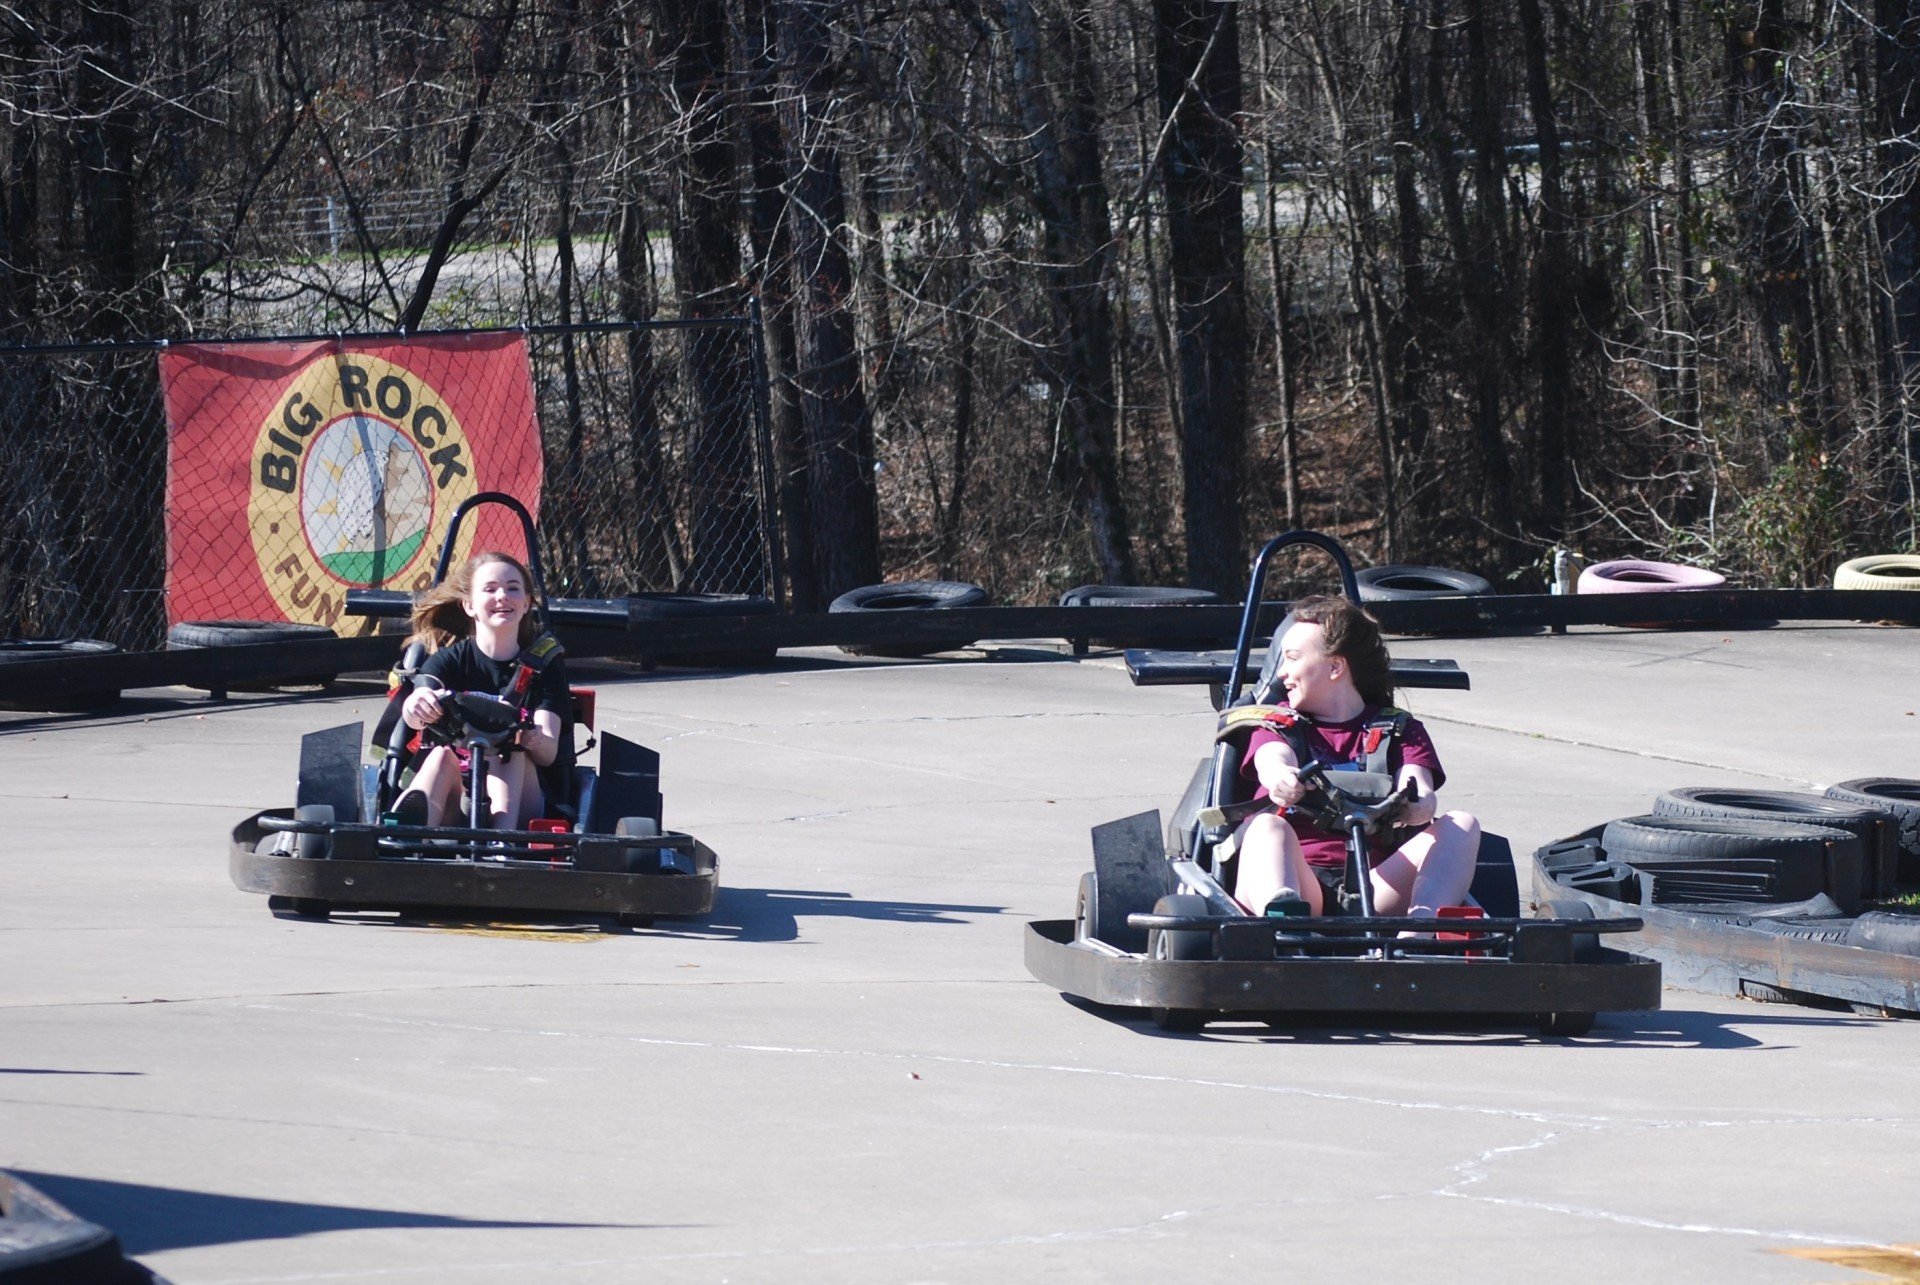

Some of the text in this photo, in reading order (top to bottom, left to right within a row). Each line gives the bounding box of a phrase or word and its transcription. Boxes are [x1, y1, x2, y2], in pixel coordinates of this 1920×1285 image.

[261, 365, 467, 493] BIG ROCK
[274, 553, 343, 627] FUN
